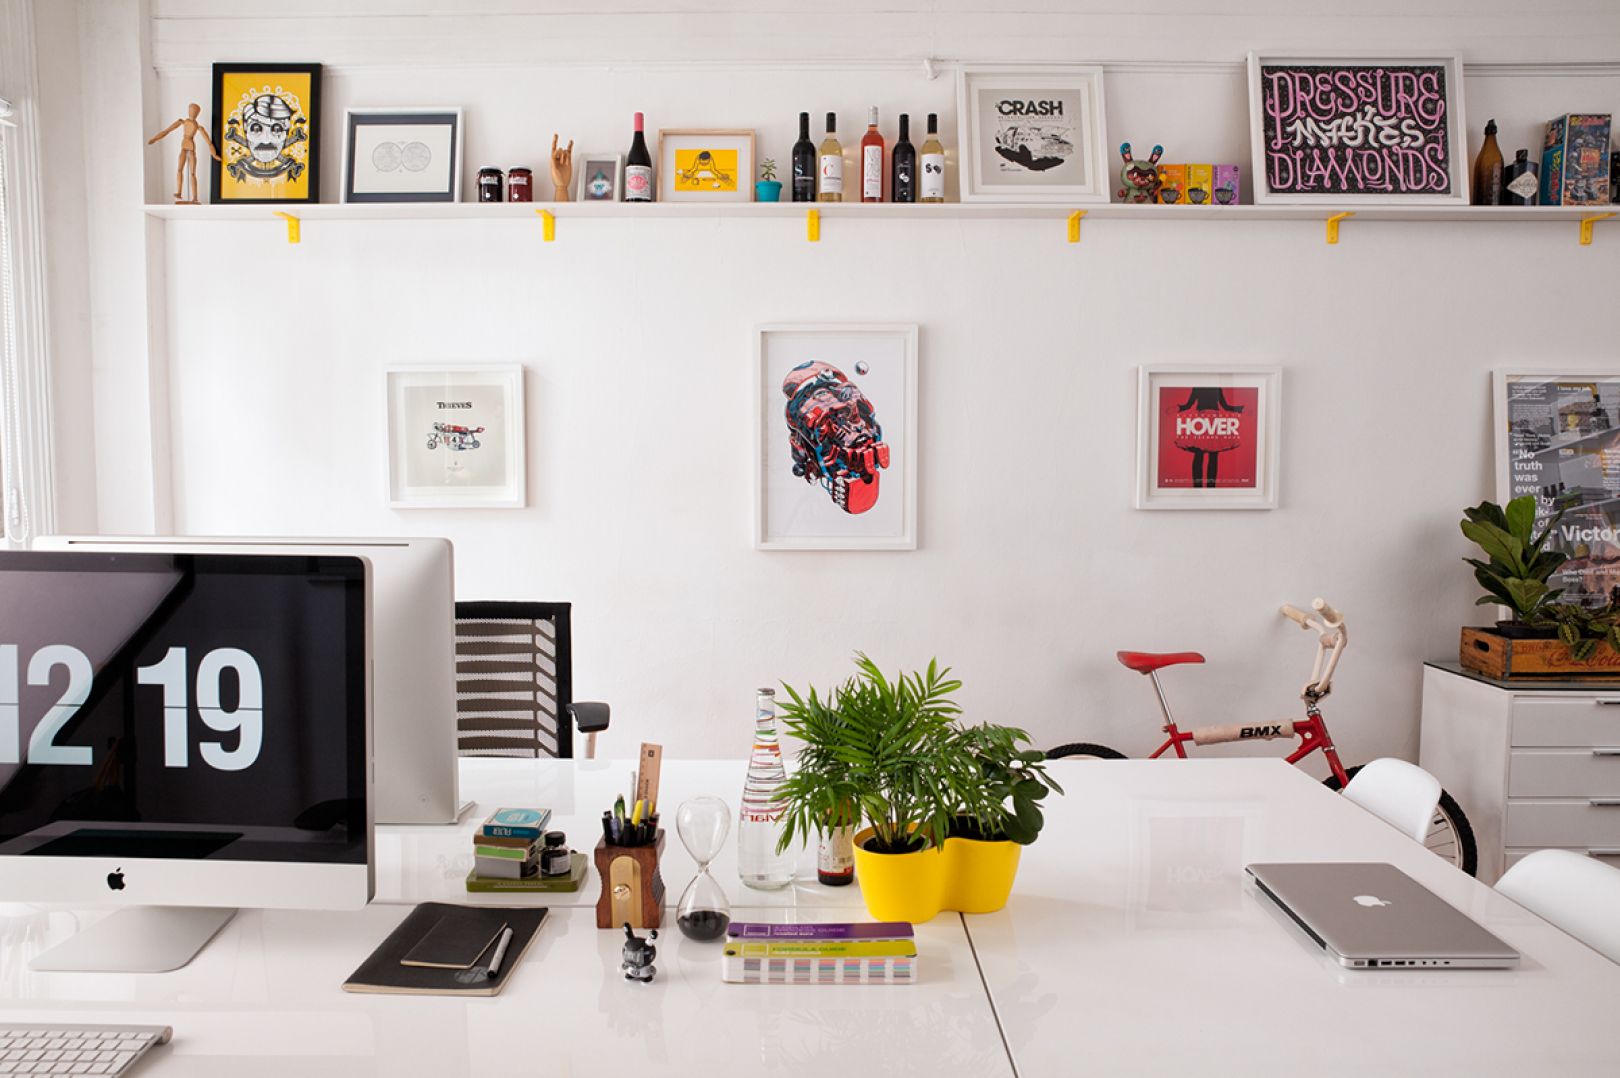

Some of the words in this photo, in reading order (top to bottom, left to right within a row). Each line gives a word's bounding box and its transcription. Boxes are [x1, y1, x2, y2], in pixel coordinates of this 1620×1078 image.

[997, 100, 1063, 115] CRASH
[1264, 69, 1445, 148] PRESSURE
[1267, 132, 1448, 191] DIAMONDS
[1176, 417, 1240, 436] HOVER
[1515, 461, 1542, 470] truth
[1515, 474, 1538, 482] was
[1515, 485, 1540, 493] ever
[1541, 494, 1555, 507] by
[137, 647, 263, 771] 19
[1240, 725, 1282, 738] BMX
